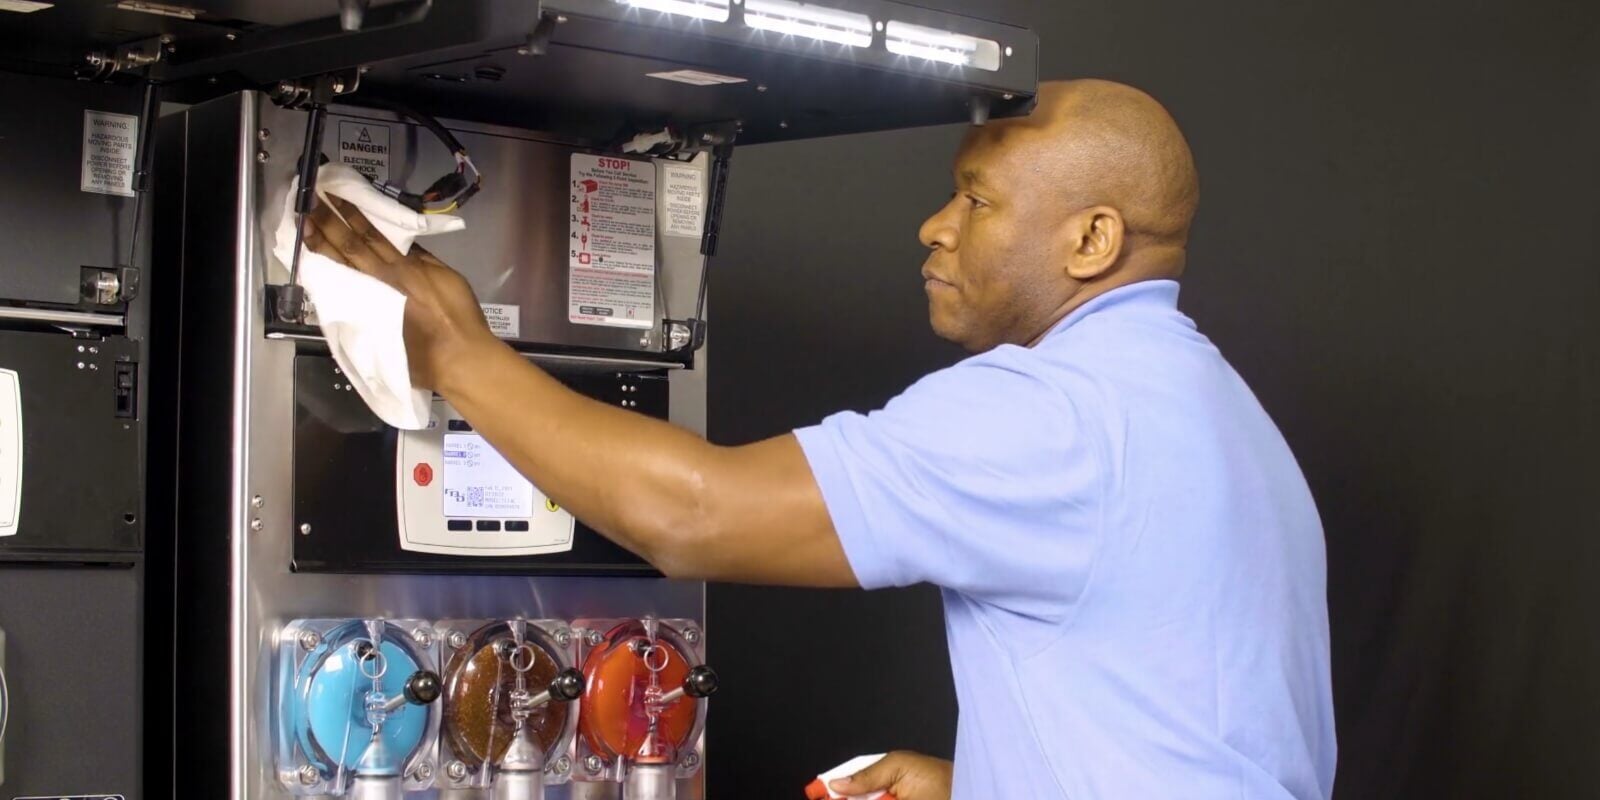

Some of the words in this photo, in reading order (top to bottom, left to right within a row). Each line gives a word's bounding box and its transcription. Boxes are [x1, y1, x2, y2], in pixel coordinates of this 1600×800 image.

[91, 133, 129, 142] HAZARDOUS
[88, 139, 112, 147] MOVING
[342, 141, 387, 154] DANGER!
[91, 155, 127, 163] DISCONNECT
[343, 155, 385, 167] ELECTRICAL
[598, 158, 630, 171] STOP!
